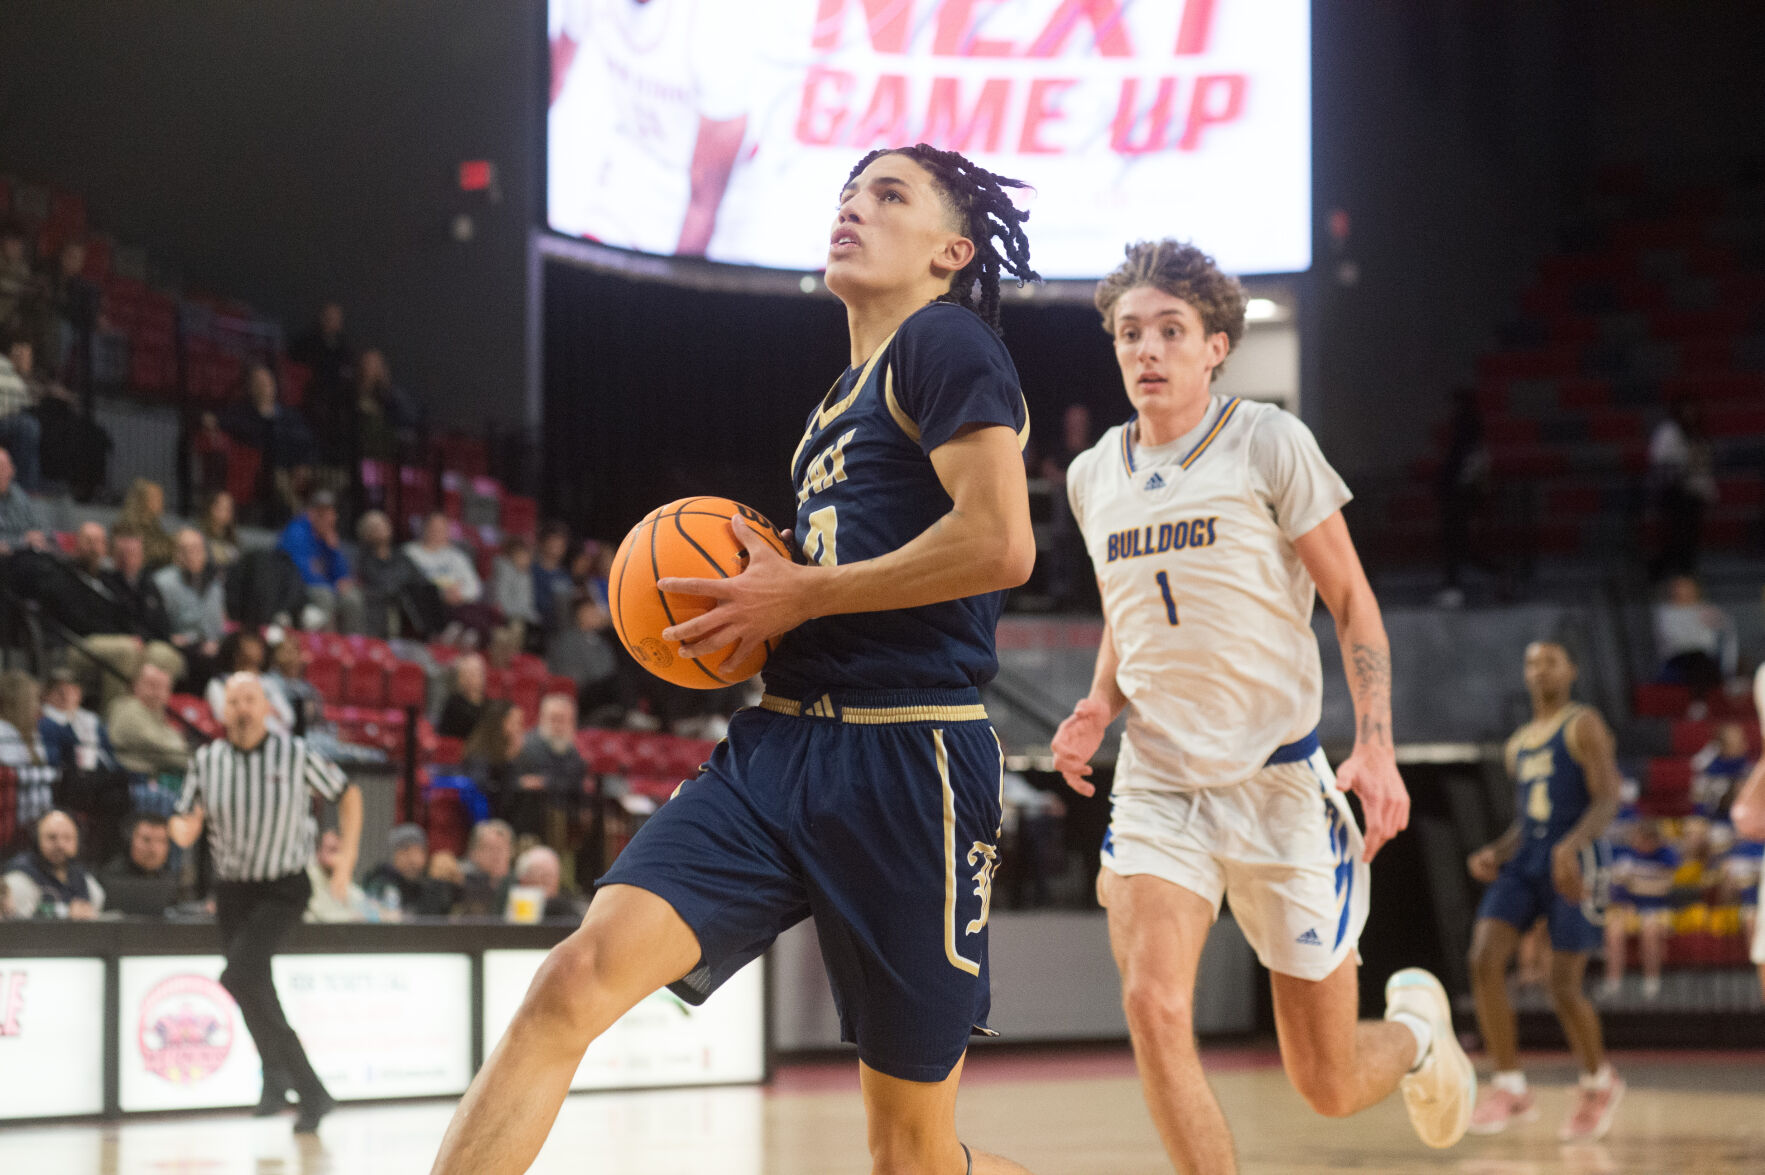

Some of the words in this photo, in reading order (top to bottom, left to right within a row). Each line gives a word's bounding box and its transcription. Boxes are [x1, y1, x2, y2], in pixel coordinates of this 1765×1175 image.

[796, 66, 1080, 154] GAME
[1109, 73, 1247, 155] UP
[1106, 516, 1219, 563] BULLDOGS
[1155, 569, 1180, 626] 1
